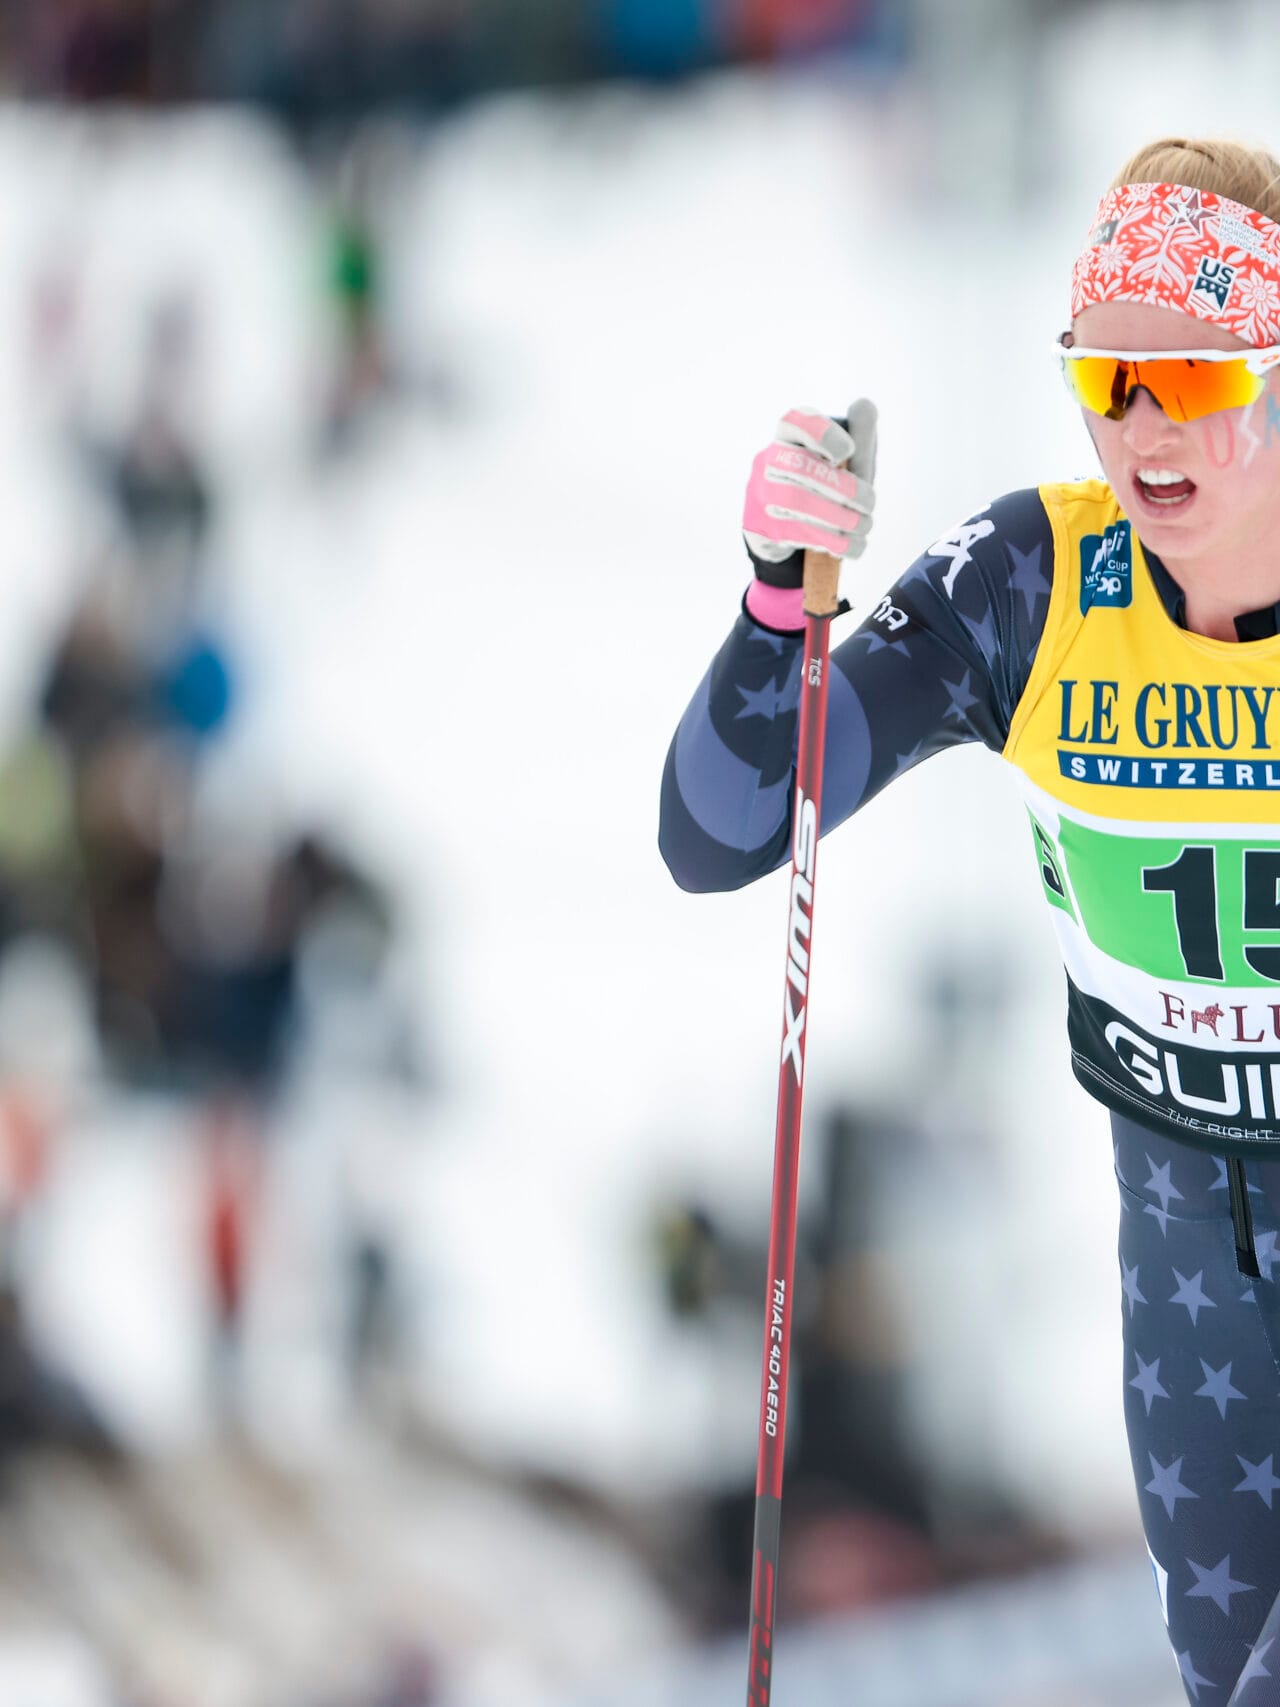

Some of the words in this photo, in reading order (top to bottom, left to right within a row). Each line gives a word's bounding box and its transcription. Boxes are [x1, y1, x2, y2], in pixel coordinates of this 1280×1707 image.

[1199, 257, 1235, 286] US
[807, 656, 823, 688] TCS
[1057, 679, 1120, 746] LE
[782, 786, 817, 1089] SWIX
[1167, 1107, 1200, 1130] THE
[1207, 1123, 1274, 1140] RIGHT
[770, 1279, 786, 1343] TRIAC
[765, 1375, 780, 1438] AERO
